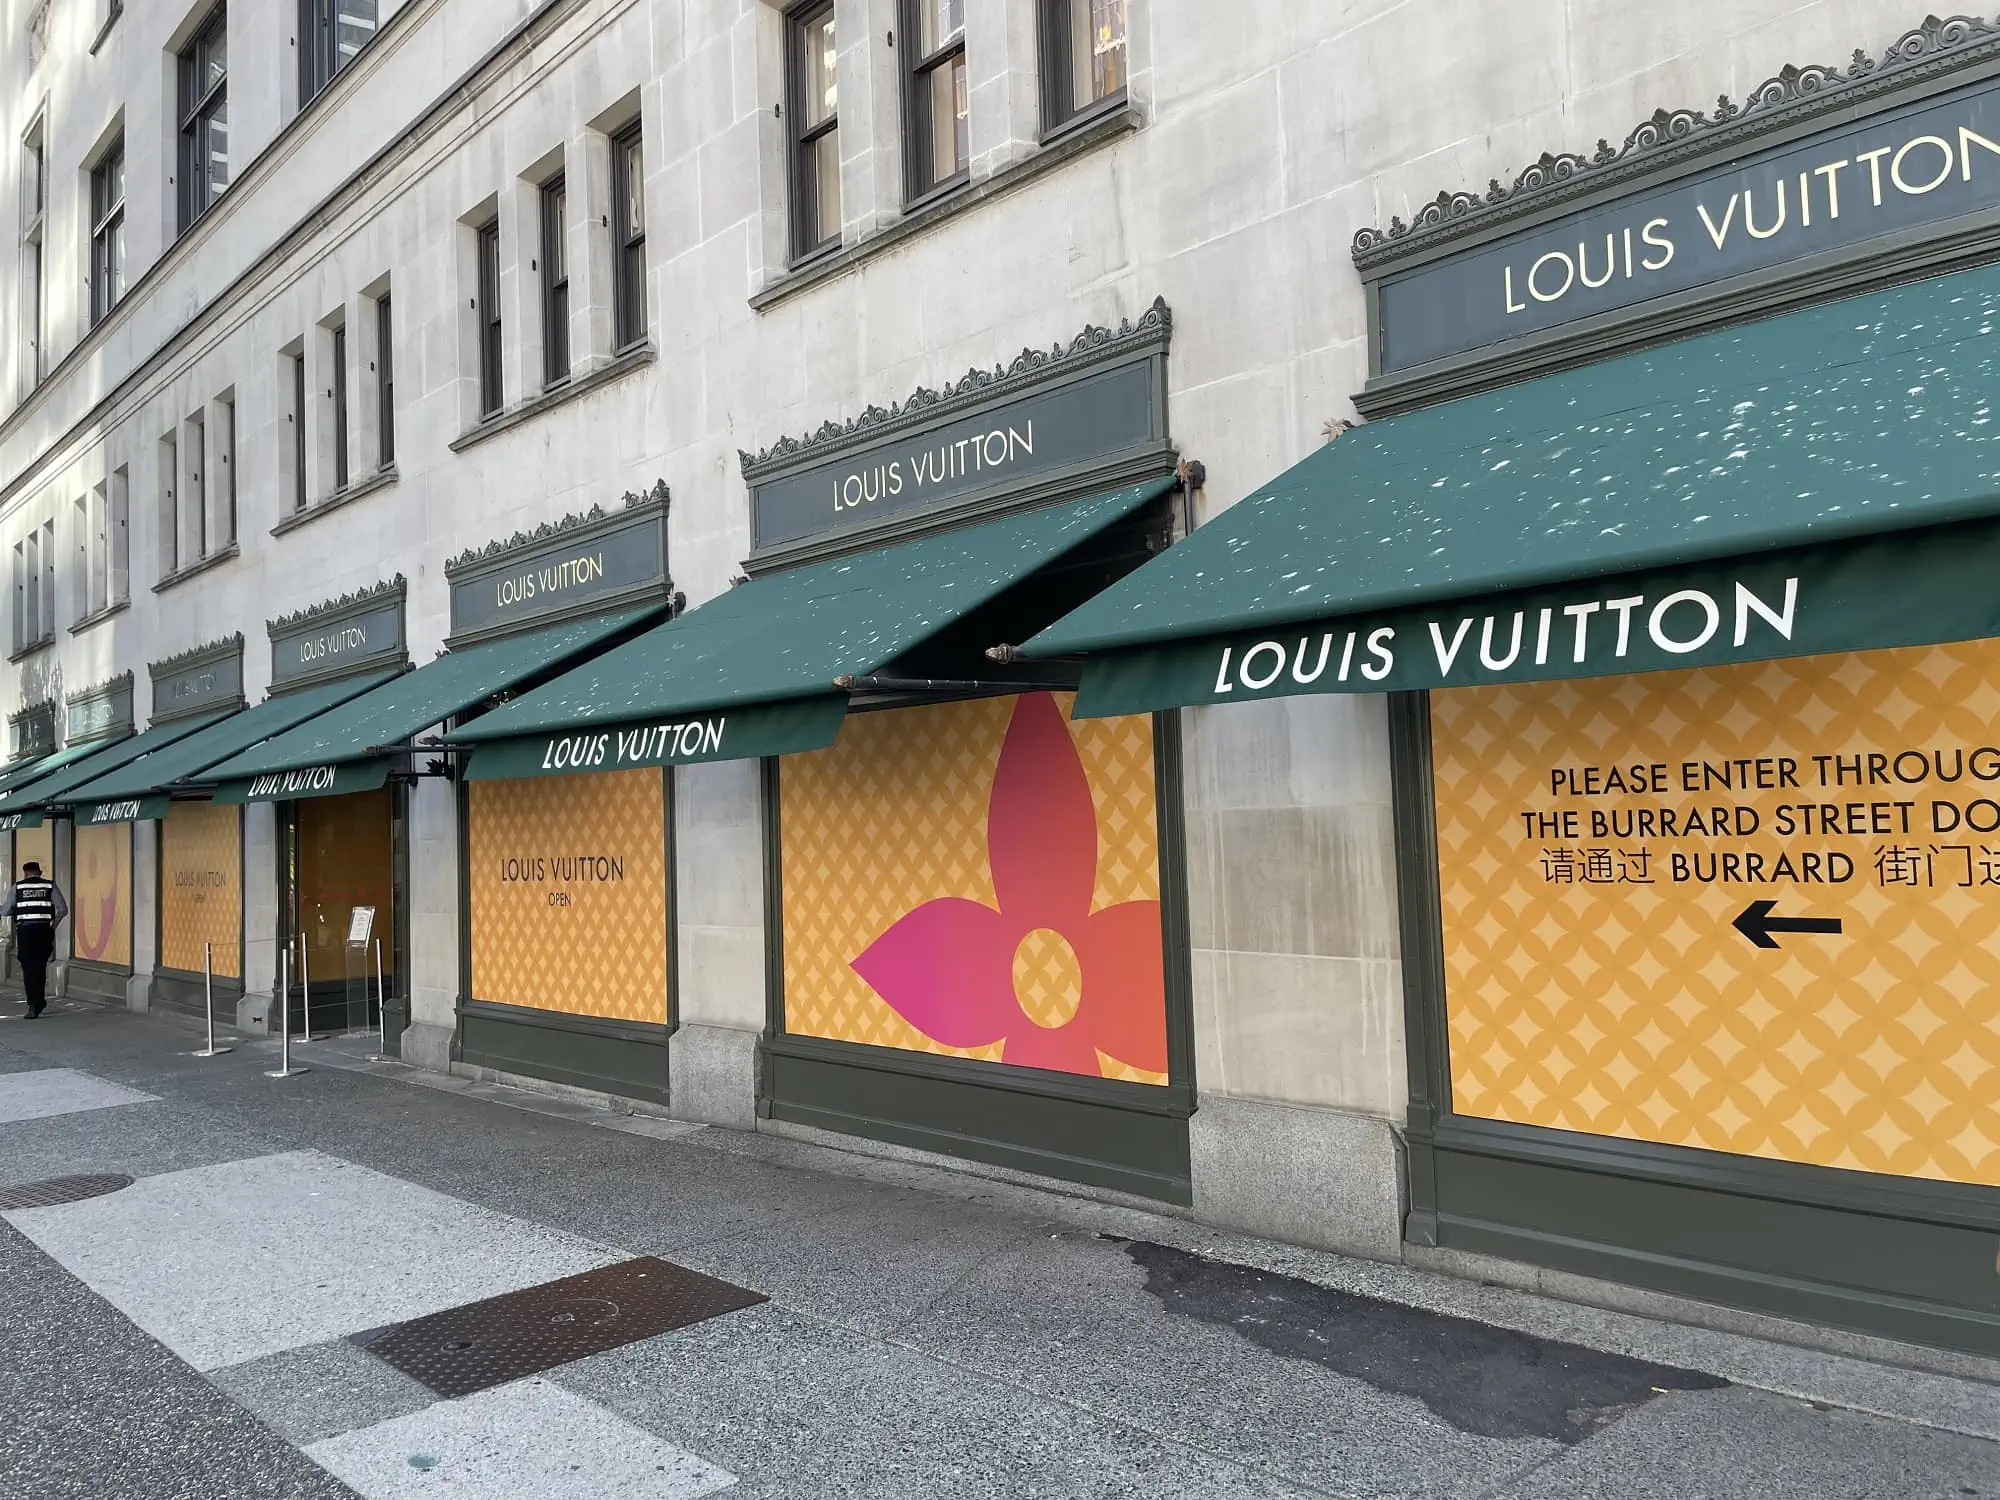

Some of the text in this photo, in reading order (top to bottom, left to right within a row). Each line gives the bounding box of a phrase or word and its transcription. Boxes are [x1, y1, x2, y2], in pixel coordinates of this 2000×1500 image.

[1503, 126, 2000, 313] LOUIS VUITTON
[833, 420, 1033, 512] LOUIS VUITTON
[497, 552, 603, 607] LOUIS VUITTON
[300, 625, 366, 662] LOUIS VUITTON
[1214, 577, 1798, 693] LOUIS VUITTON
[542, 717, 726, 769] LOUIS VUITTON
[1550, 747, 2000, 796] PLEASE ENTER THROUG
[1520, 798, 2000, 840] THE BURRARD STREET DO
[501, 855, 624, 881] LOUIS VUITTON
[1540, 847, 1656, 885] 请通过
[1671, 852, 1855, 883] BURRARD
[548, 892, 572, 906] OPEN
